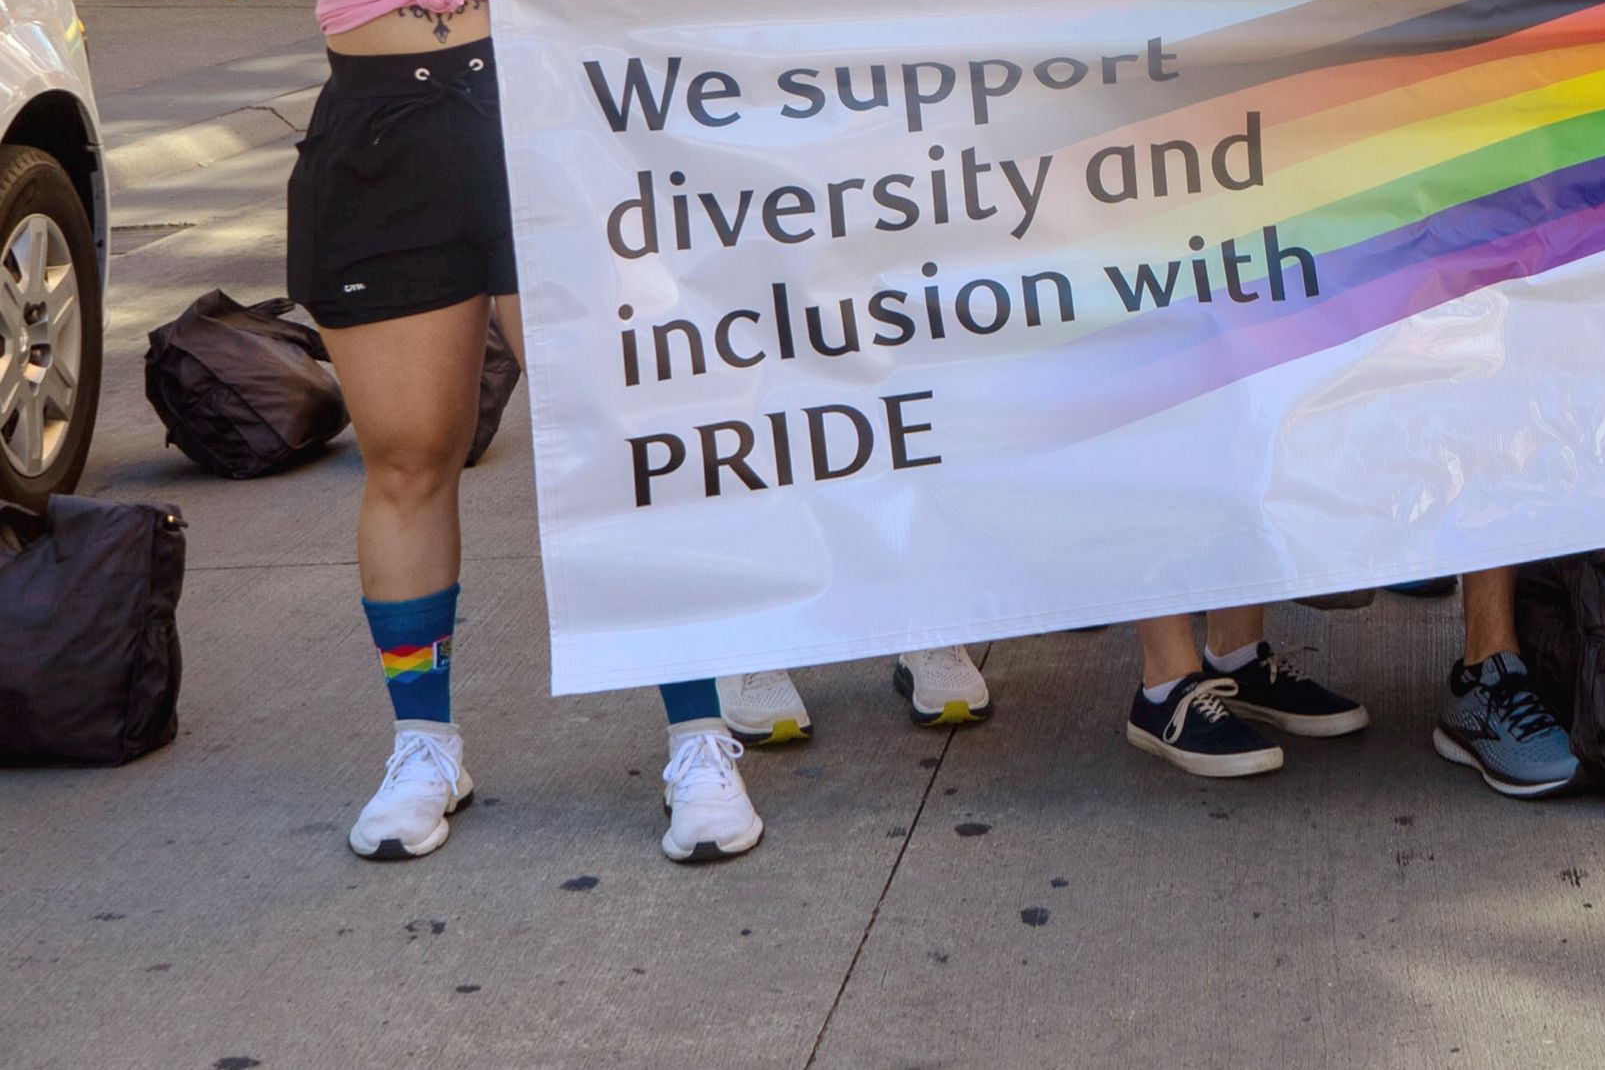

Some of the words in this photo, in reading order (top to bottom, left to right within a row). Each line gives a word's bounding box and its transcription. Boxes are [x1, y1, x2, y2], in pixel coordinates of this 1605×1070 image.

[583, 56, 742, 133] We
[779, 36, 1181, 133] support
[607, 144, 1053, 260] diversity
[1086, 111, 1265, 204] and
[617, 261, 1076, 387] inclusion
[1104, 225, 1320, 314] with
[625, 389, 942, 508] PRIDE
